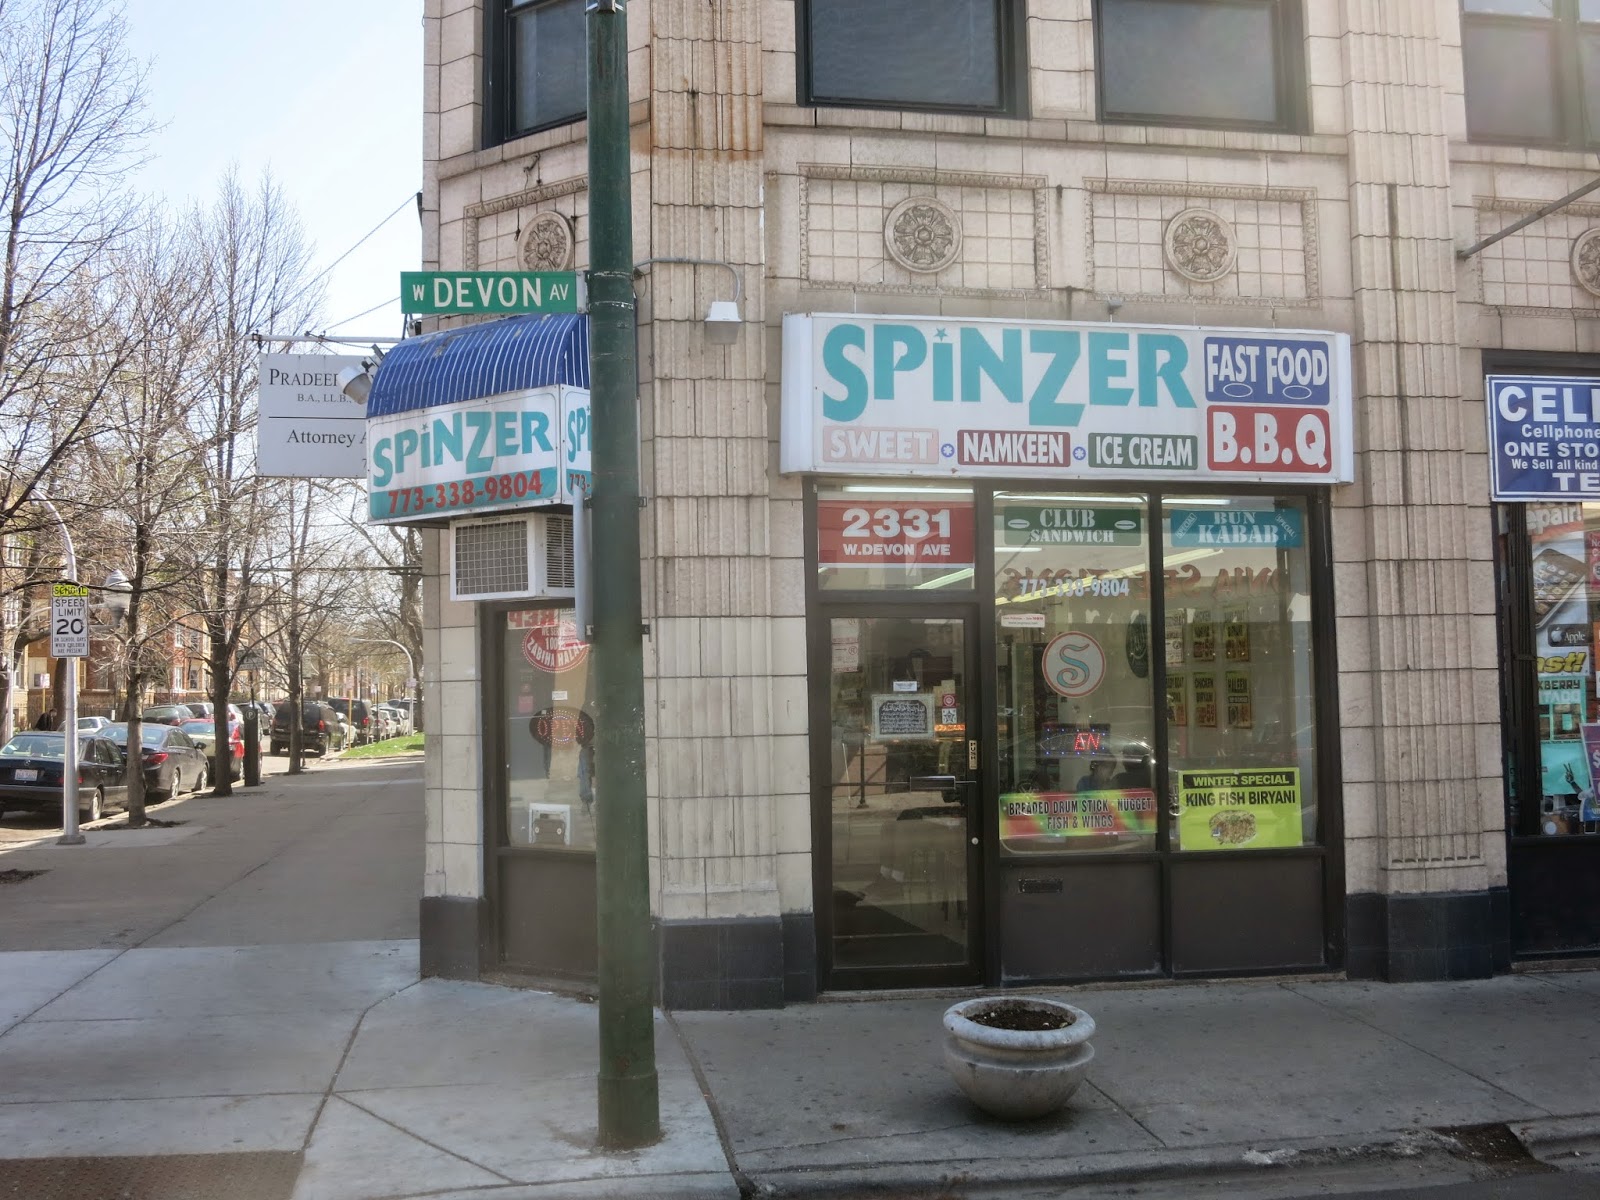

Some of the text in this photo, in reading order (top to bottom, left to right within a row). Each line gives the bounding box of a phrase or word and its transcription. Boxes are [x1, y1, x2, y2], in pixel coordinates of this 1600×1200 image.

[412, 277, 570, 308] W DEVON AV
[1206, 343, 1328, 395] FAST FOOD
[287, 429, 356, 448] Attorney
[829, 429, 932, 461] SWEET
[1212, 411, 1328, 469] B.B.Q
[963, 433, 1065, 465] NAMKEEN
[1095, 436, 1193, 468] ICE CREAM
[1504, 442, 1550, 457] ONE
[1512, 459, 1528, 470] We
[1532, 459, 1553, 470] Sell
[1557, 460, 1571, 470] all
[388, 470, 543, 514] 773-338-9804
[842, 508, 951, 538] 2331
[1039, 508, 1096, 528] CLUB
[1176, 513, 1196, 538] SPECIAL
[1213, 511, 1257, 525] BUN
[1276, 514, 1297, 538] SPECIAL
[1029, 528, 1115, 543] SANDWICH
[1198, 524, 1279, 544] KABAB
[921, 543, 951, 556] AVE
[1018, 578, 1131, 597] 773-338-9804
[55, 598, 85, 607] SPEED
[58, 608, 82, 616] LIMIT
[56, 618, 84, 635] 20
[1564, 631, 1586, 643] Apple
[526, 637, 555, 667] ZABIHA
[1192, 775, 1290, 787] WINTER SPECIAL
[1053, 800, 1078, 814] DRUM
[1082, 799, 1108, 813] STICK
[1117, 797, 1152, 812] NUGGET
[1186, 790, 1296, 807] KING FISH BIRYANI
[1047, 815, 1113, 830] FISH & WINGS
